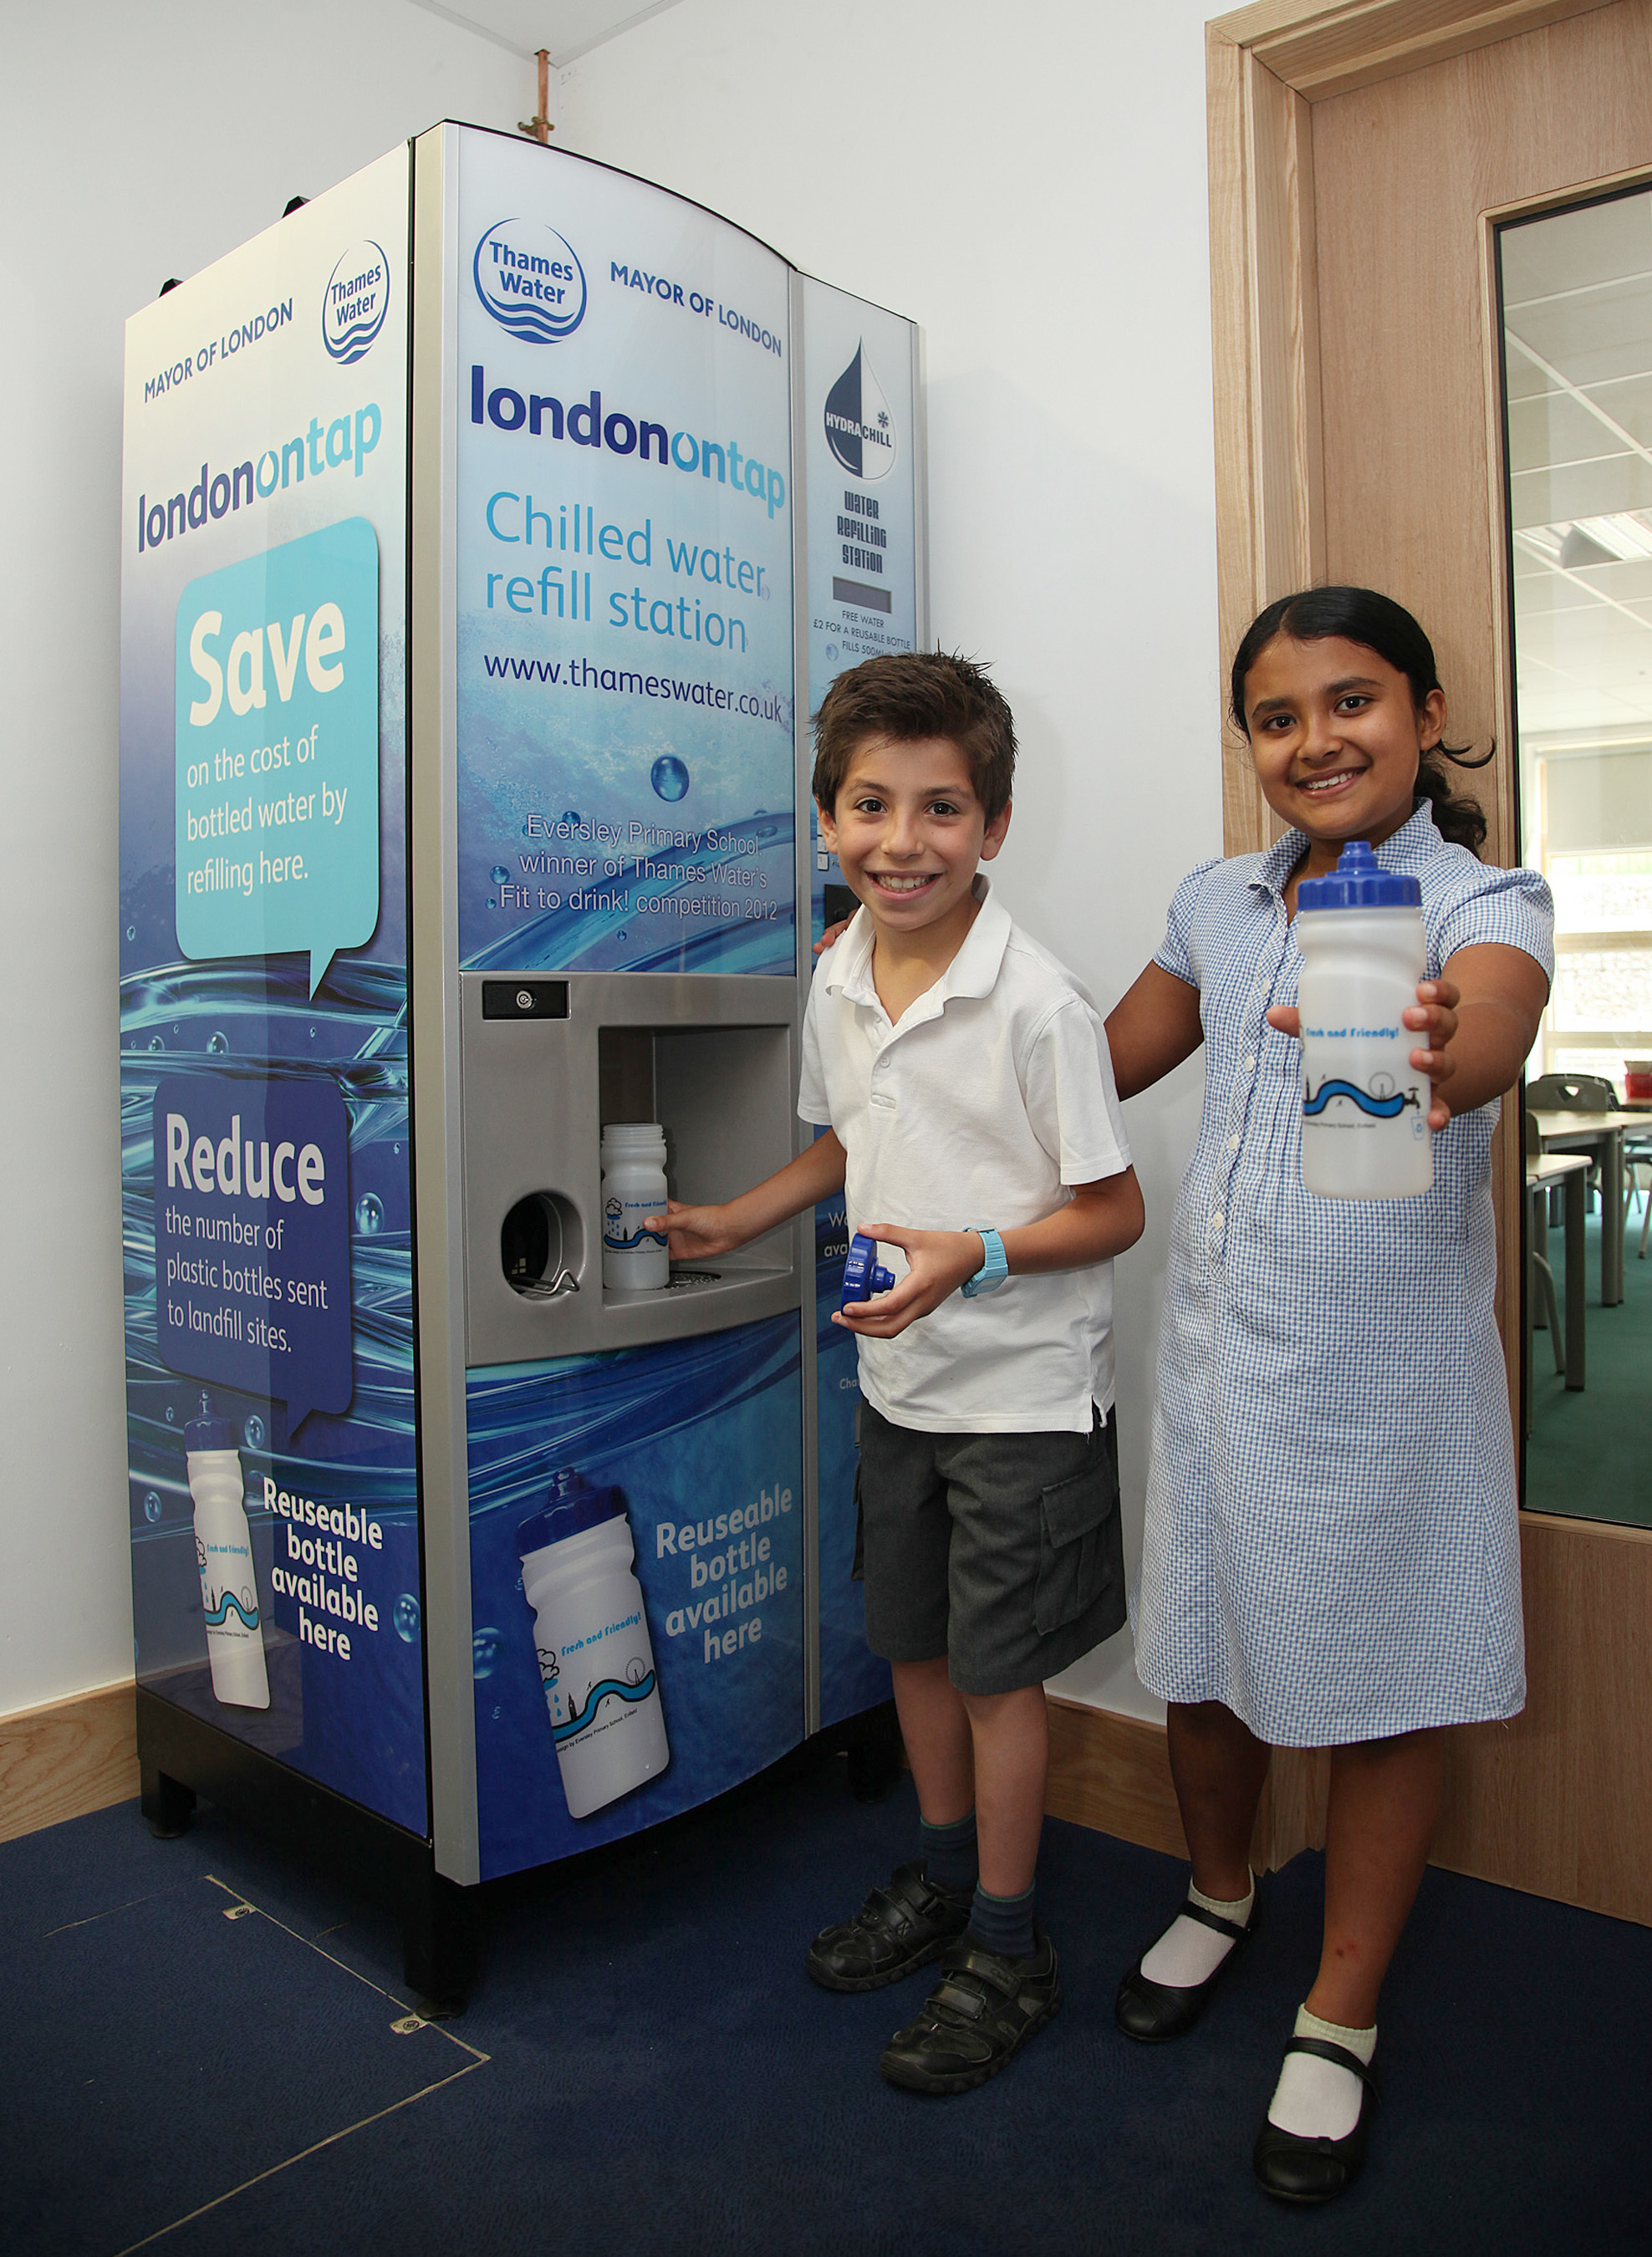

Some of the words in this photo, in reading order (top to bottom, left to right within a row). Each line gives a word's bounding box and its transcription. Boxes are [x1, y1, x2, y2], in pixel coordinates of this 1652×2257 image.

[330, 264, 382, 305] Thames
[489, 241, 574, 282] Thames
[499, 270, 566, 304] Water
[336, 292, 376, 327] Water
[610, 261, 685, 307] MAYOR
[689, 292, 714, 318] OF
[719, 303, 783, 358] LONDON
[144, 357, 193, 404] MAYOR
[196, 341, 217, 371] OF
[222, 298, 293, 359] LONDON
[486, 491, 651, 567] Chilled
[666, 538, 766, 597] water
[487, 565, 591, 621] refill
[609, 587, 747, 653] station
[813, 619, 823, 629] £2
[826, 621, 841, 633] FOR
[844, 626, 849, 634] A
[851, 627, 885, 644] REUSABLE
[887, 636, 910, 650] BOTTLE
[843, 610, 859, 622] FREE
[860, 614, 885, 628] WATER
[189, 602, 346, 726] Save
[842, 640, 859, 653] FILLS
[483, 654, 783, 723] www.thameswater.co.uk
[187, 762, 209, 788] on
[214, 747, 245, 782] the
[251, 736, 291, 774] cost
[297, 723, 319, 761] of
[187, 797, 252, 842] bottled
[258, 792, 316, 829] water
[323, 781, 348, 825] by
[527, 813, 622, 847] Eversley
[629, 821, 701, 854] Primary
[187, 857, 253, 896] refilling
[260, 850, 308, 885] here.
[519, 853, 597, 877] winner
[604, 855, 625, 877] of
[631, 856, 706, 884] Thames
[711, 862, 767, 889] Water's
[500, 884, 529, 909] Fit
[538, 888, 561, 910] to
[569, 887, 629, 913] drink!
[636, 894, 741, 920] competition
[744, 898, 778, 921] 2012
[1327, 1027, 1347, 1037] and
[166, 1113, 325, 1205] Reduce
[166, 1205, 191, 1236] the
[196, 1213, 260, 1246] number
[265, 1219, 285, 1251] of
[166, 1251, 218, 1288] plastic
[222, 1260, 282, 1301] bottles
[288, 1279, 328, 1309] sent
[167, 1299, 184, 1327] to
[188, 1301, 242, 1341] landfill
[247, 1317, 292, 1353] sites.
[263, 1476, 383, 1550] Reuseable
[655, 1482, 793, 1559] Reuseable
[287, 1523, 359, 1582] bottle
[690, 1531, 771, 1589] bottle
[271, 1565, 380, 1632] available
[665, 1562, 788, 1637] available
[299, 1605, 351, 1661] here
[561, 1639, 584, 1656] Fresh
[586, 1629, 602, 1644] and
[604, 1611, 641, 1636] Friendly!
[704, 1616, 762, 1663] here
